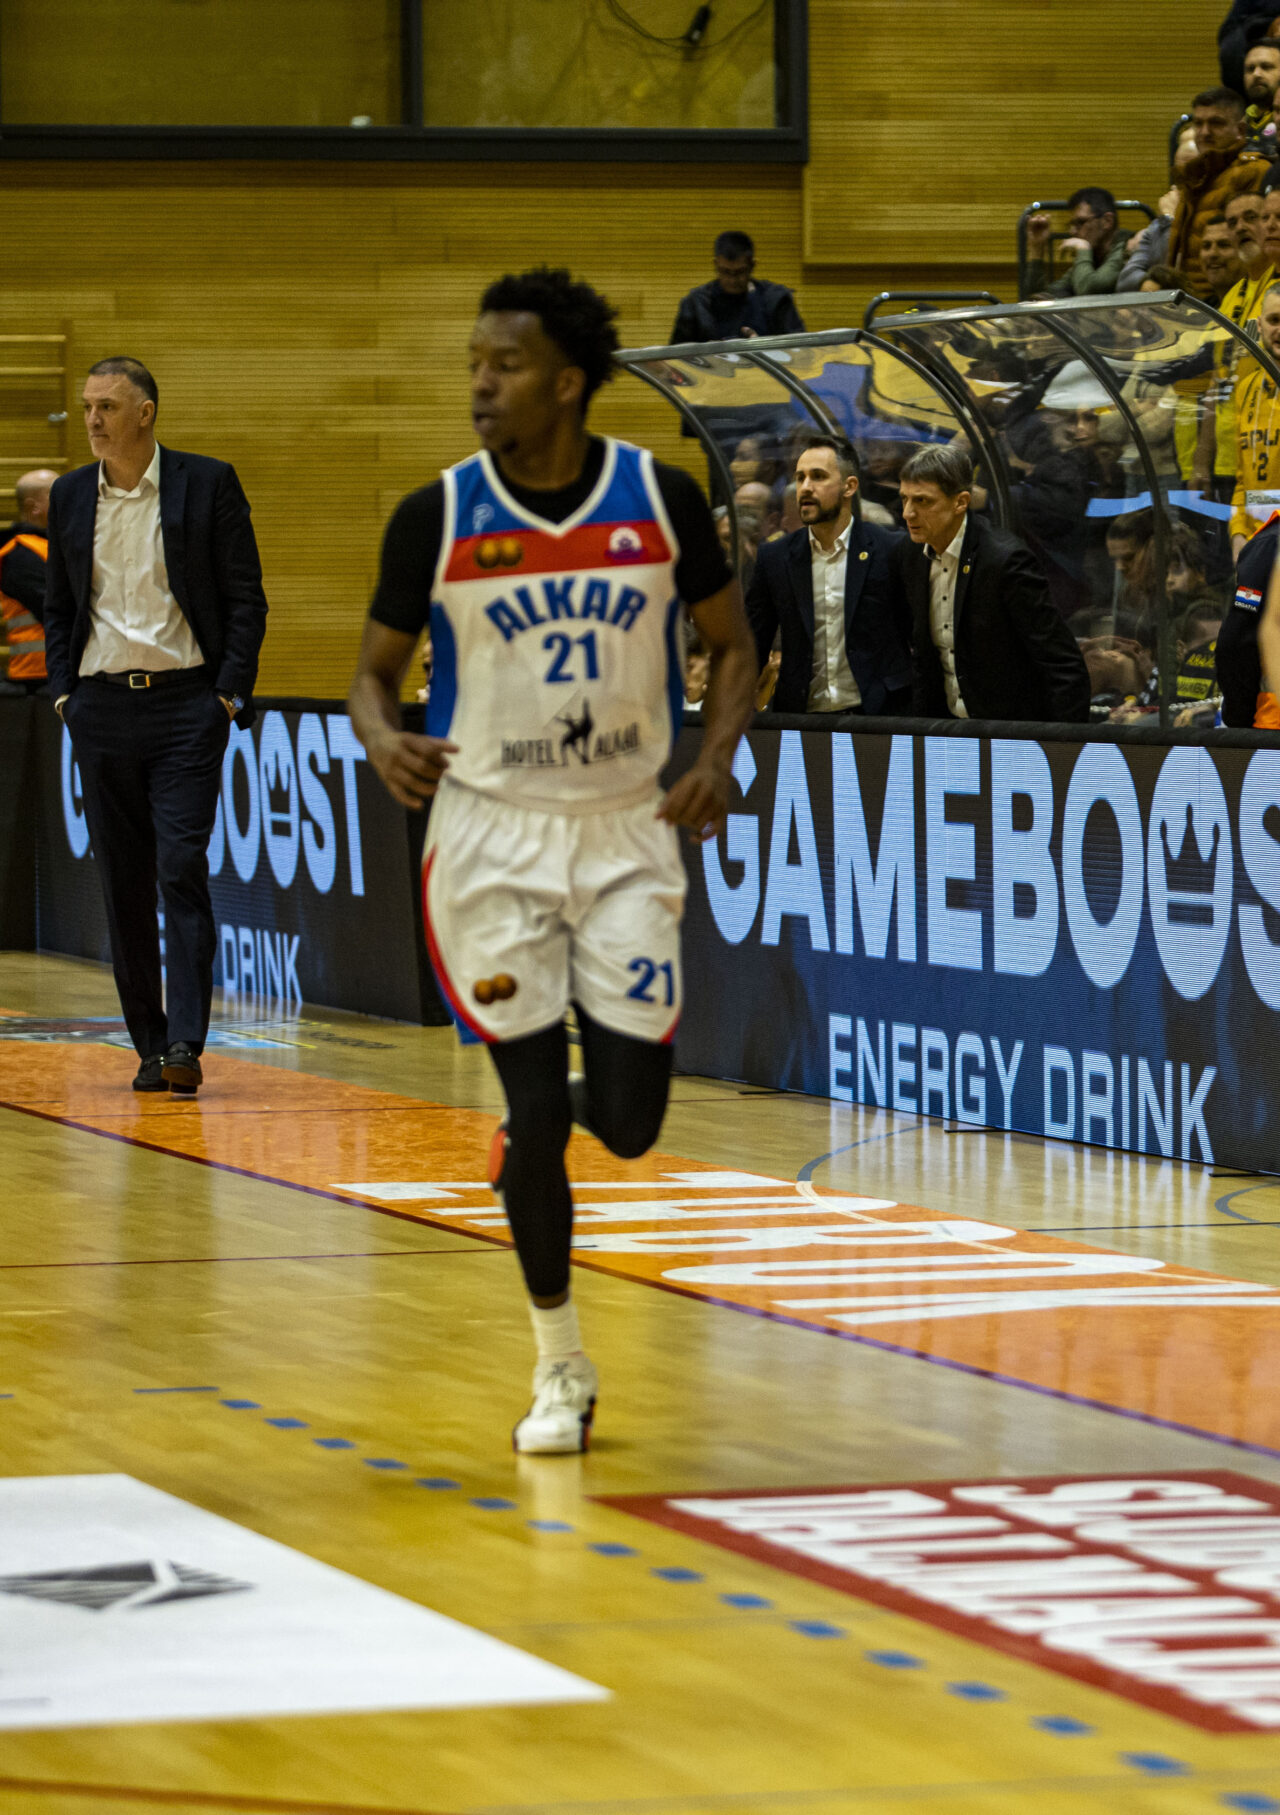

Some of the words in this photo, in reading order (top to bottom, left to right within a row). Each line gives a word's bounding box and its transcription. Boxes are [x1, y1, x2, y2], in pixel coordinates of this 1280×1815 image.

[1257, 453, 1268, 481] 2
[484, 576, 648, 643] ALKAR
[1234, 601, 1257, 613] CROATIA
[542, 630, 600, 683] 21
[220, 923, 304, 1004] DRINK
[625, 956, 674, 1007] 21
[828, 1012, 1024, 1130] ENERGY
[1043, 1044, 1218, 1164] DRINK
